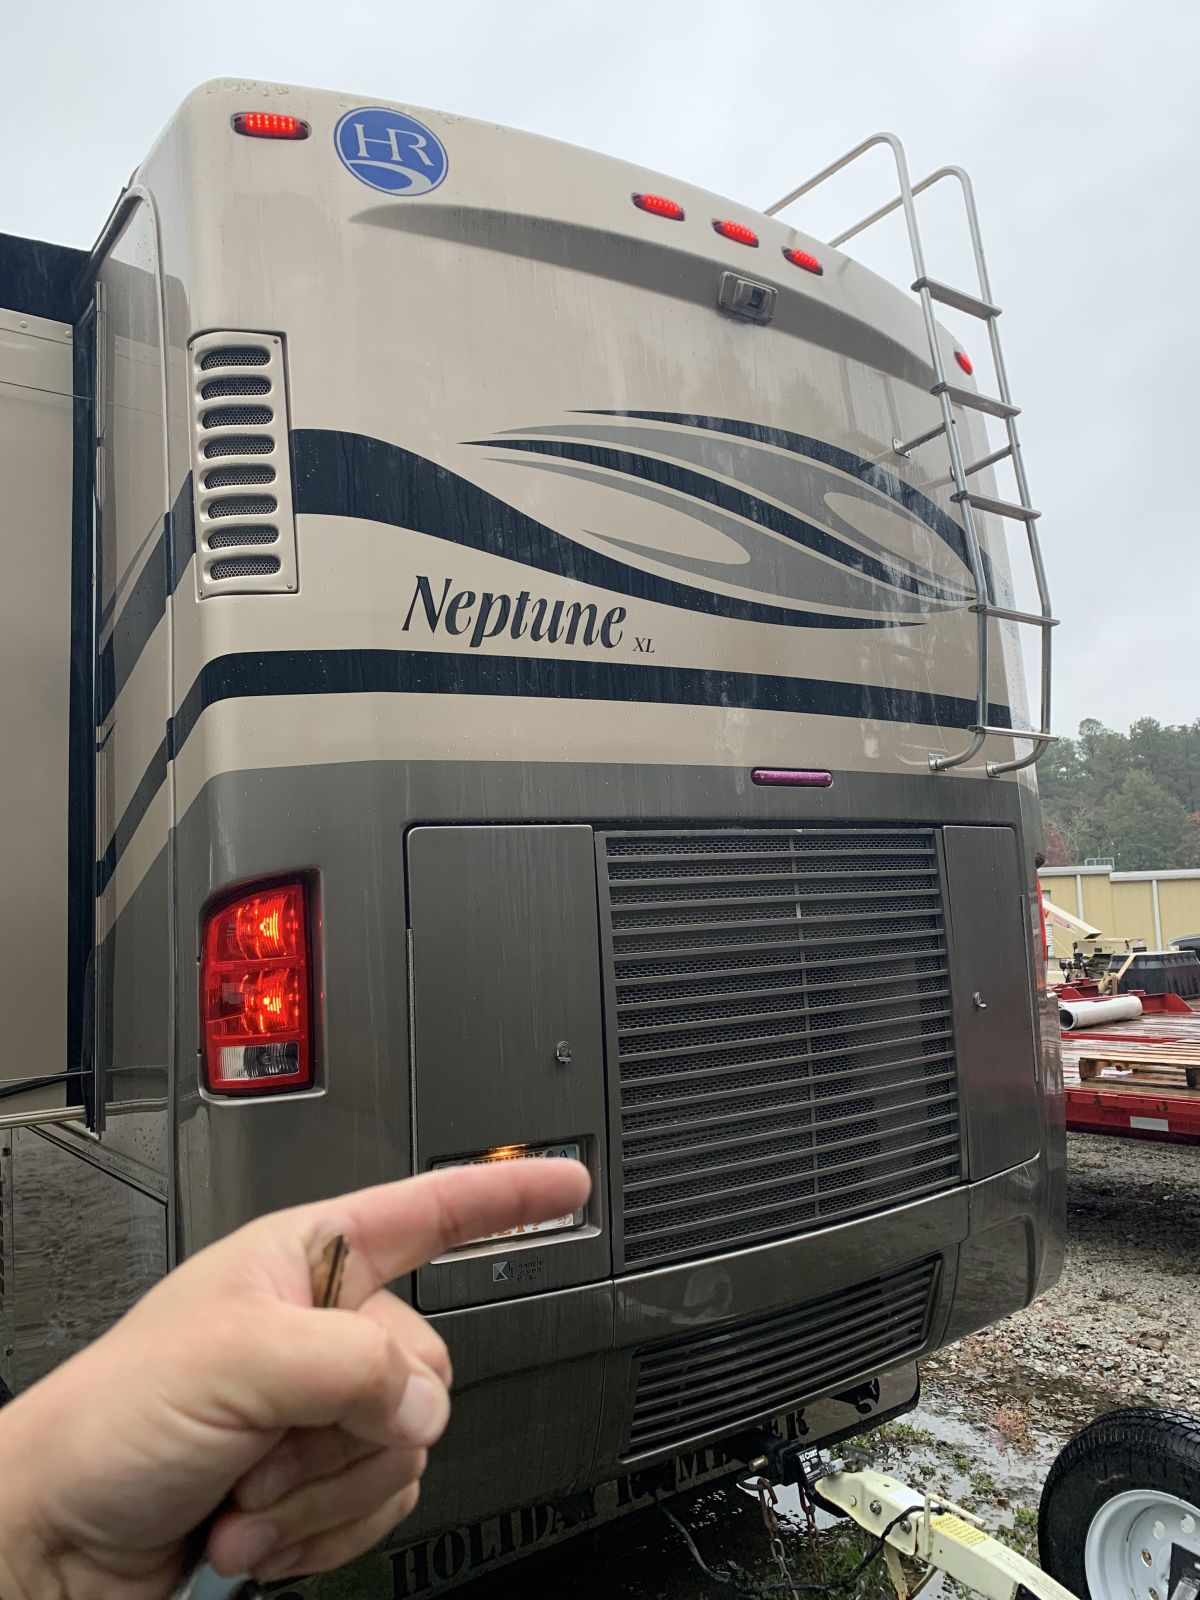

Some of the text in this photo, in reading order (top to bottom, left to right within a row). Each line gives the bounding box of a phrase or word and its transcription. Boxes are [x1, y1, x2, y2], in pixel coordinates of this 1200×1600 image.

[353, 123, 434, 166] HR
[402, 575, 655, 653] Neptune XL
